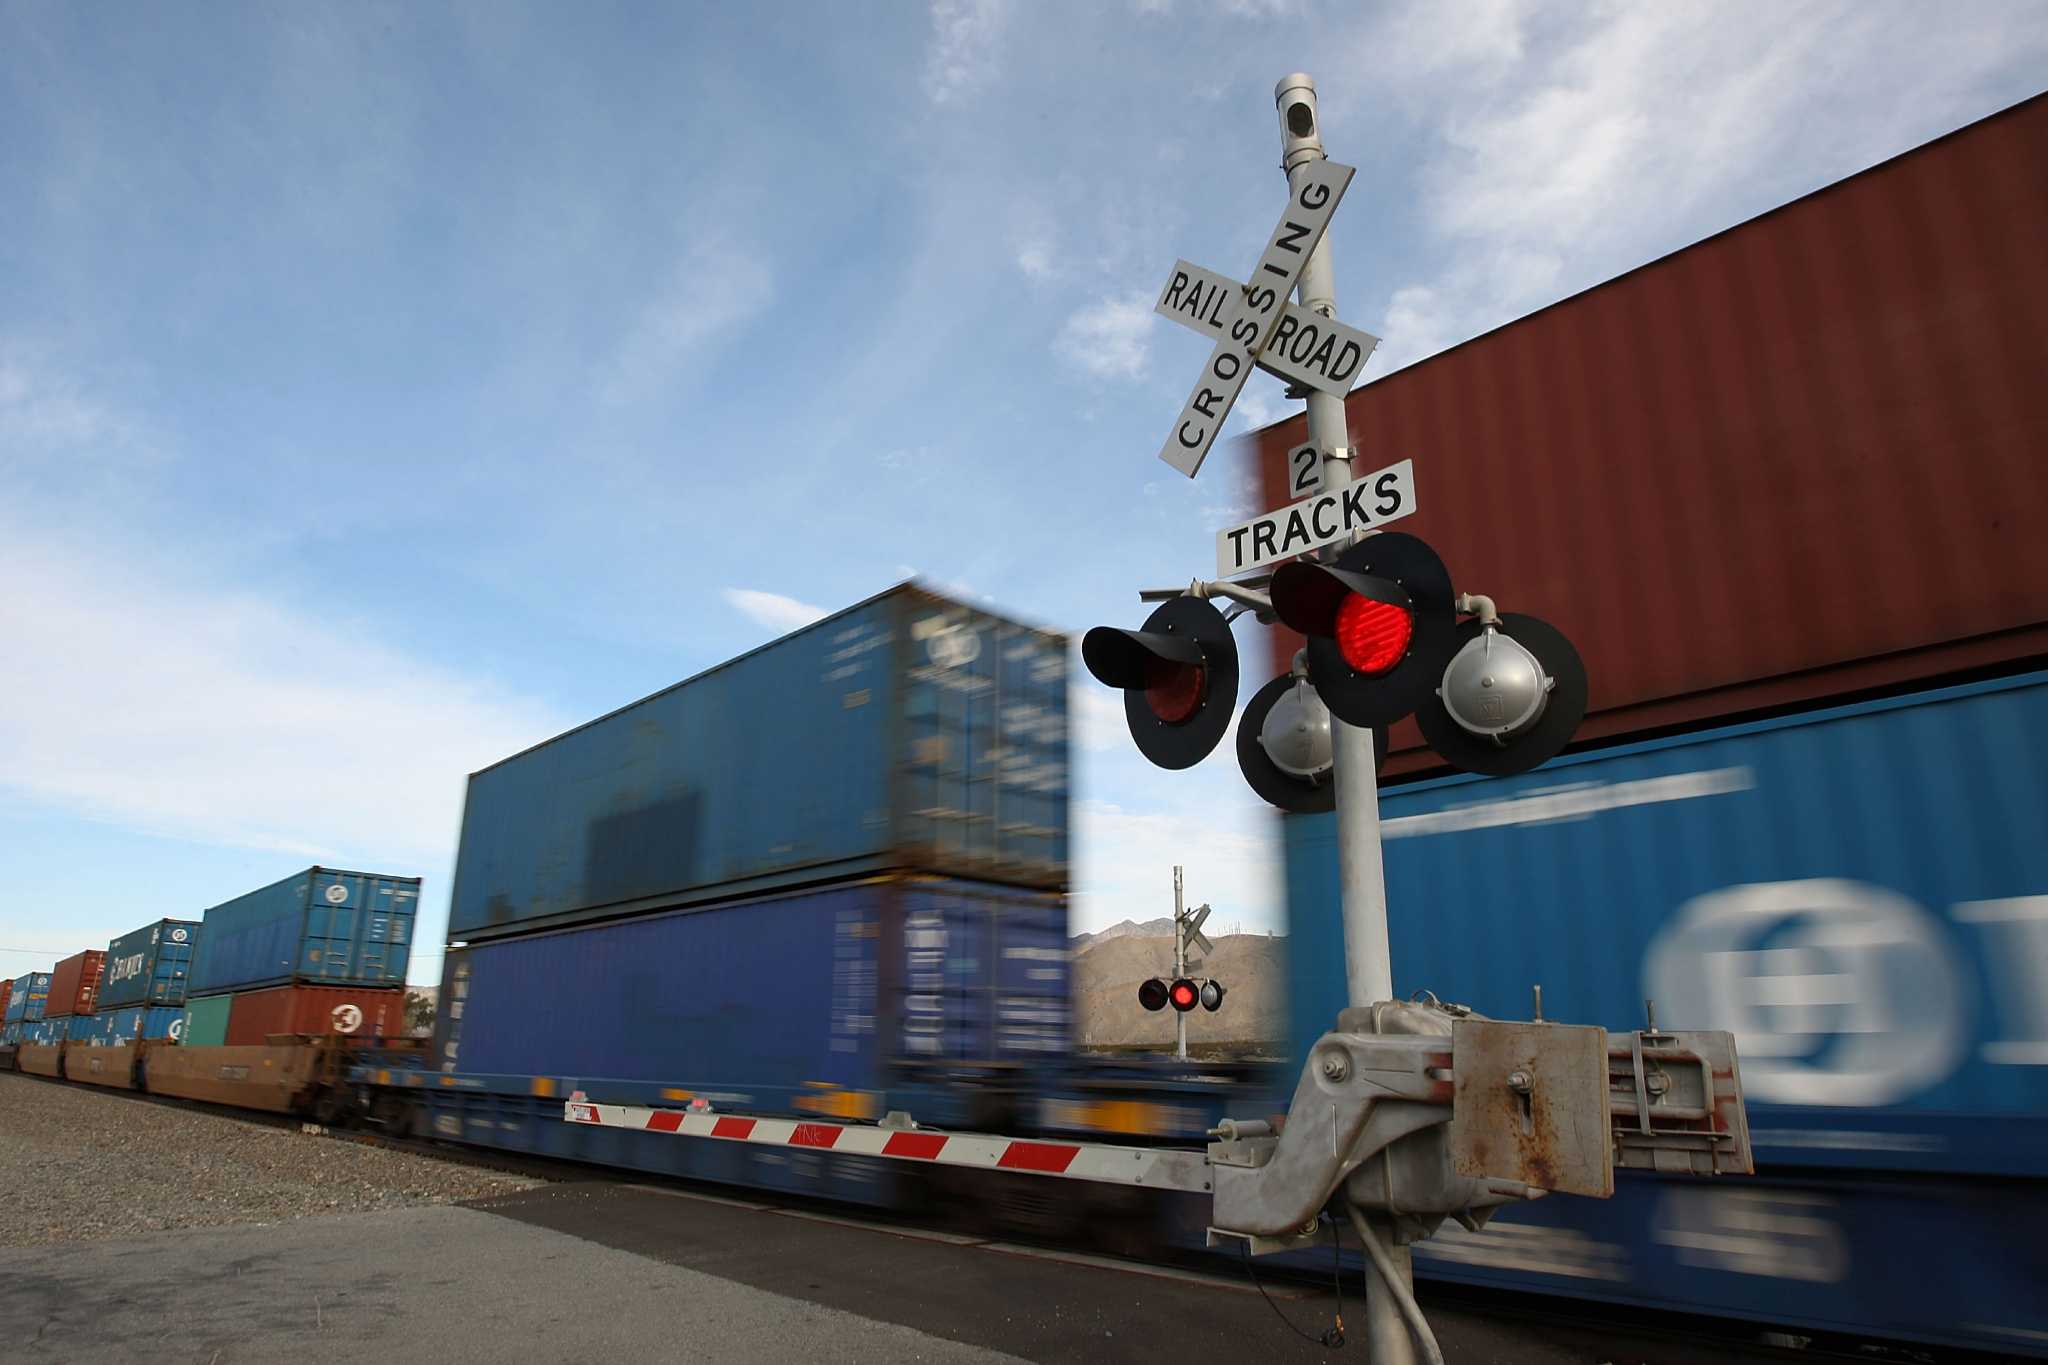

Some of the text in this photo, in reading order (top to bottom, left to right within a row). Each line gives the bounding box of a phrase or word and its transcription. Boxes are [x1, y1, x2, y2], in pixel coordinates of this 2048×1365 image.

[1163, 271, 1361, 383] RAIL ROAD
[1178, 182, 1331, 449] CROSSING
[1227, 472, 1402, 568] TRACKS
[1293, 447, 1319, 491] 2
